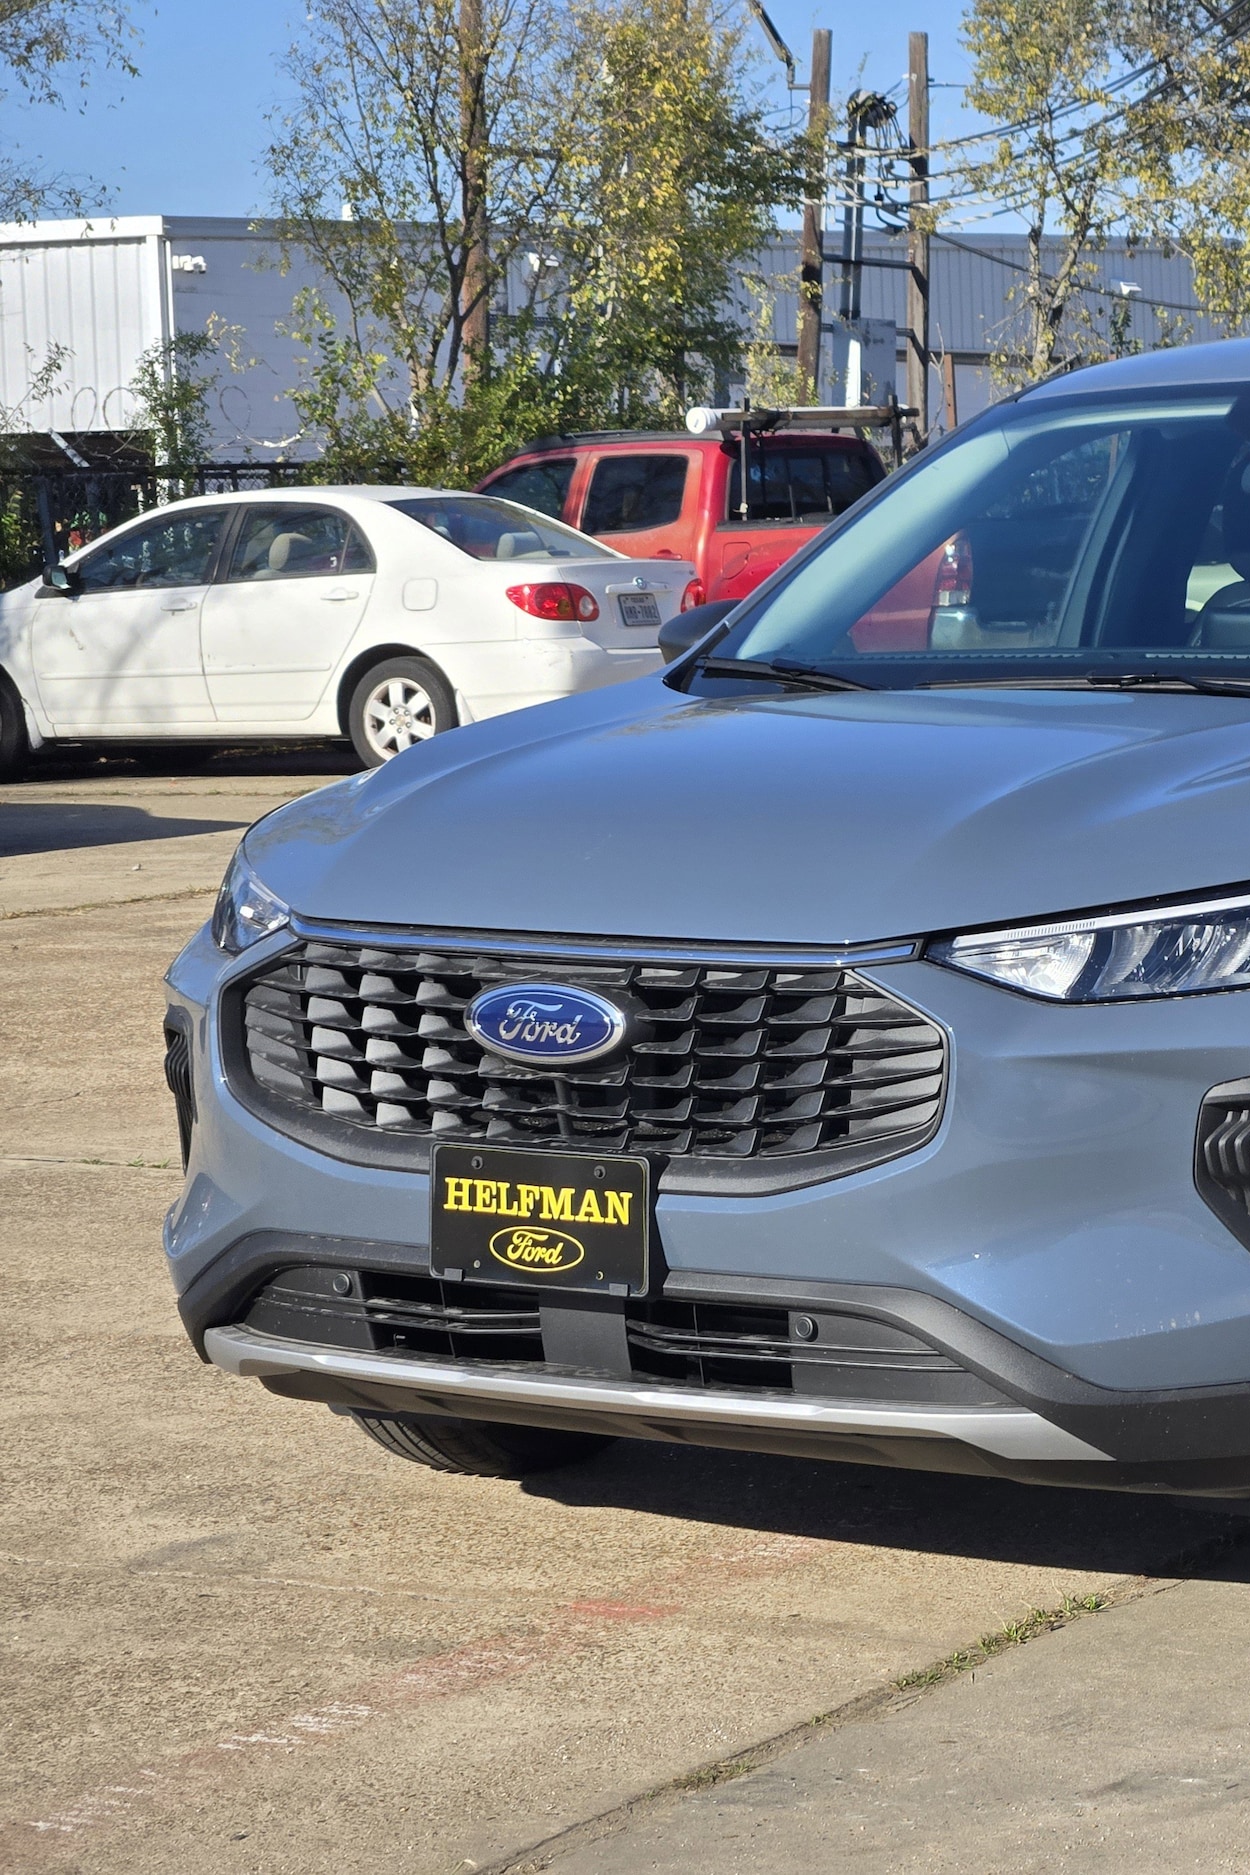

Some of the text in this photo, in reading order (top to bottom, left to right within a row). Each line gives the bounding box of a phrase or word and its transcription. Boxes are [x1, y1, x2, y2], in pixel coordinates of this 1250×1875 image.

[498, 999, 582, 1046] Ford
[443, 1176, 633, 1226] HELFMAN
[506, 1230, 564, 1266] Ford
